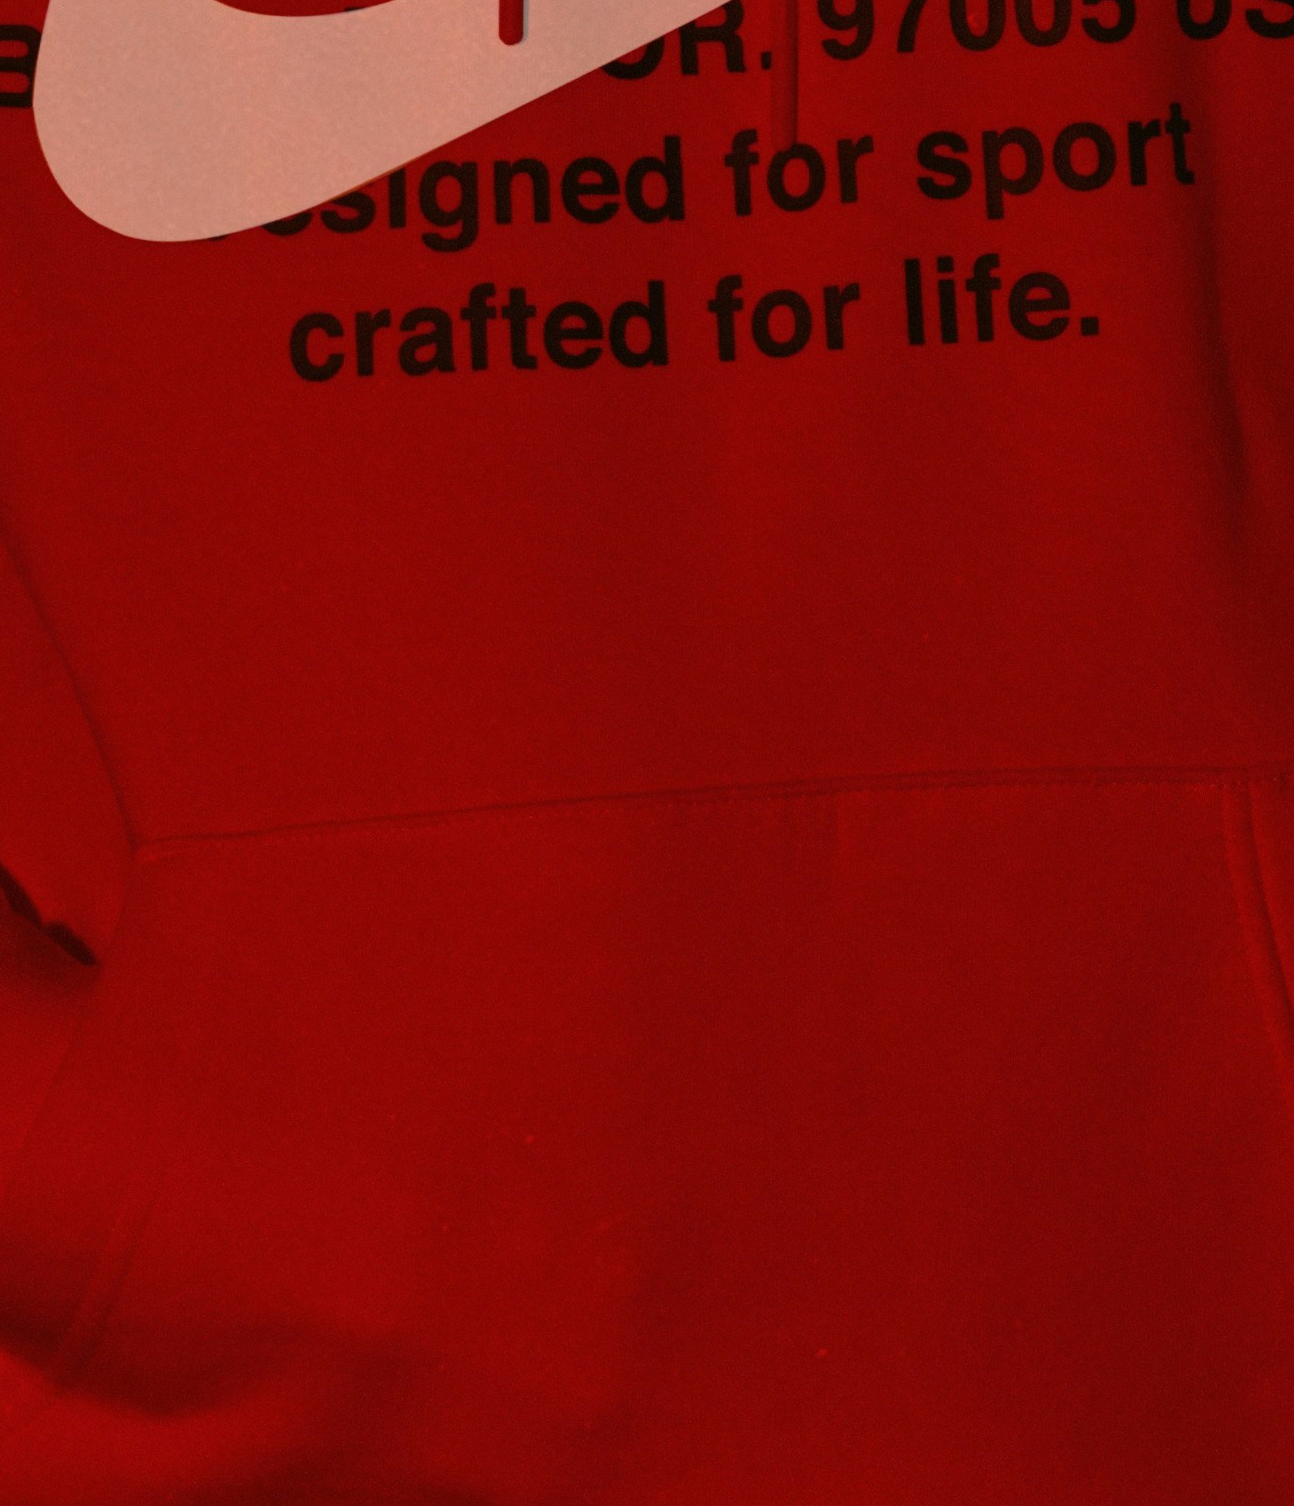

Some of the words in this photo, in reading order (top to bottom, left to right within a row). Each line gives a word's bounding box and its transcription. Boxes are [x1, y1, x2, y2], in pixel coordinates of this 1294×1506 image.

[724, 129, 873, 216] for
[917, 103, 1195, 219] sport
[289, 280, 668, 382] crafted
[708, 275, 861, 361] for
[904, 253, 1099, 345] life.
